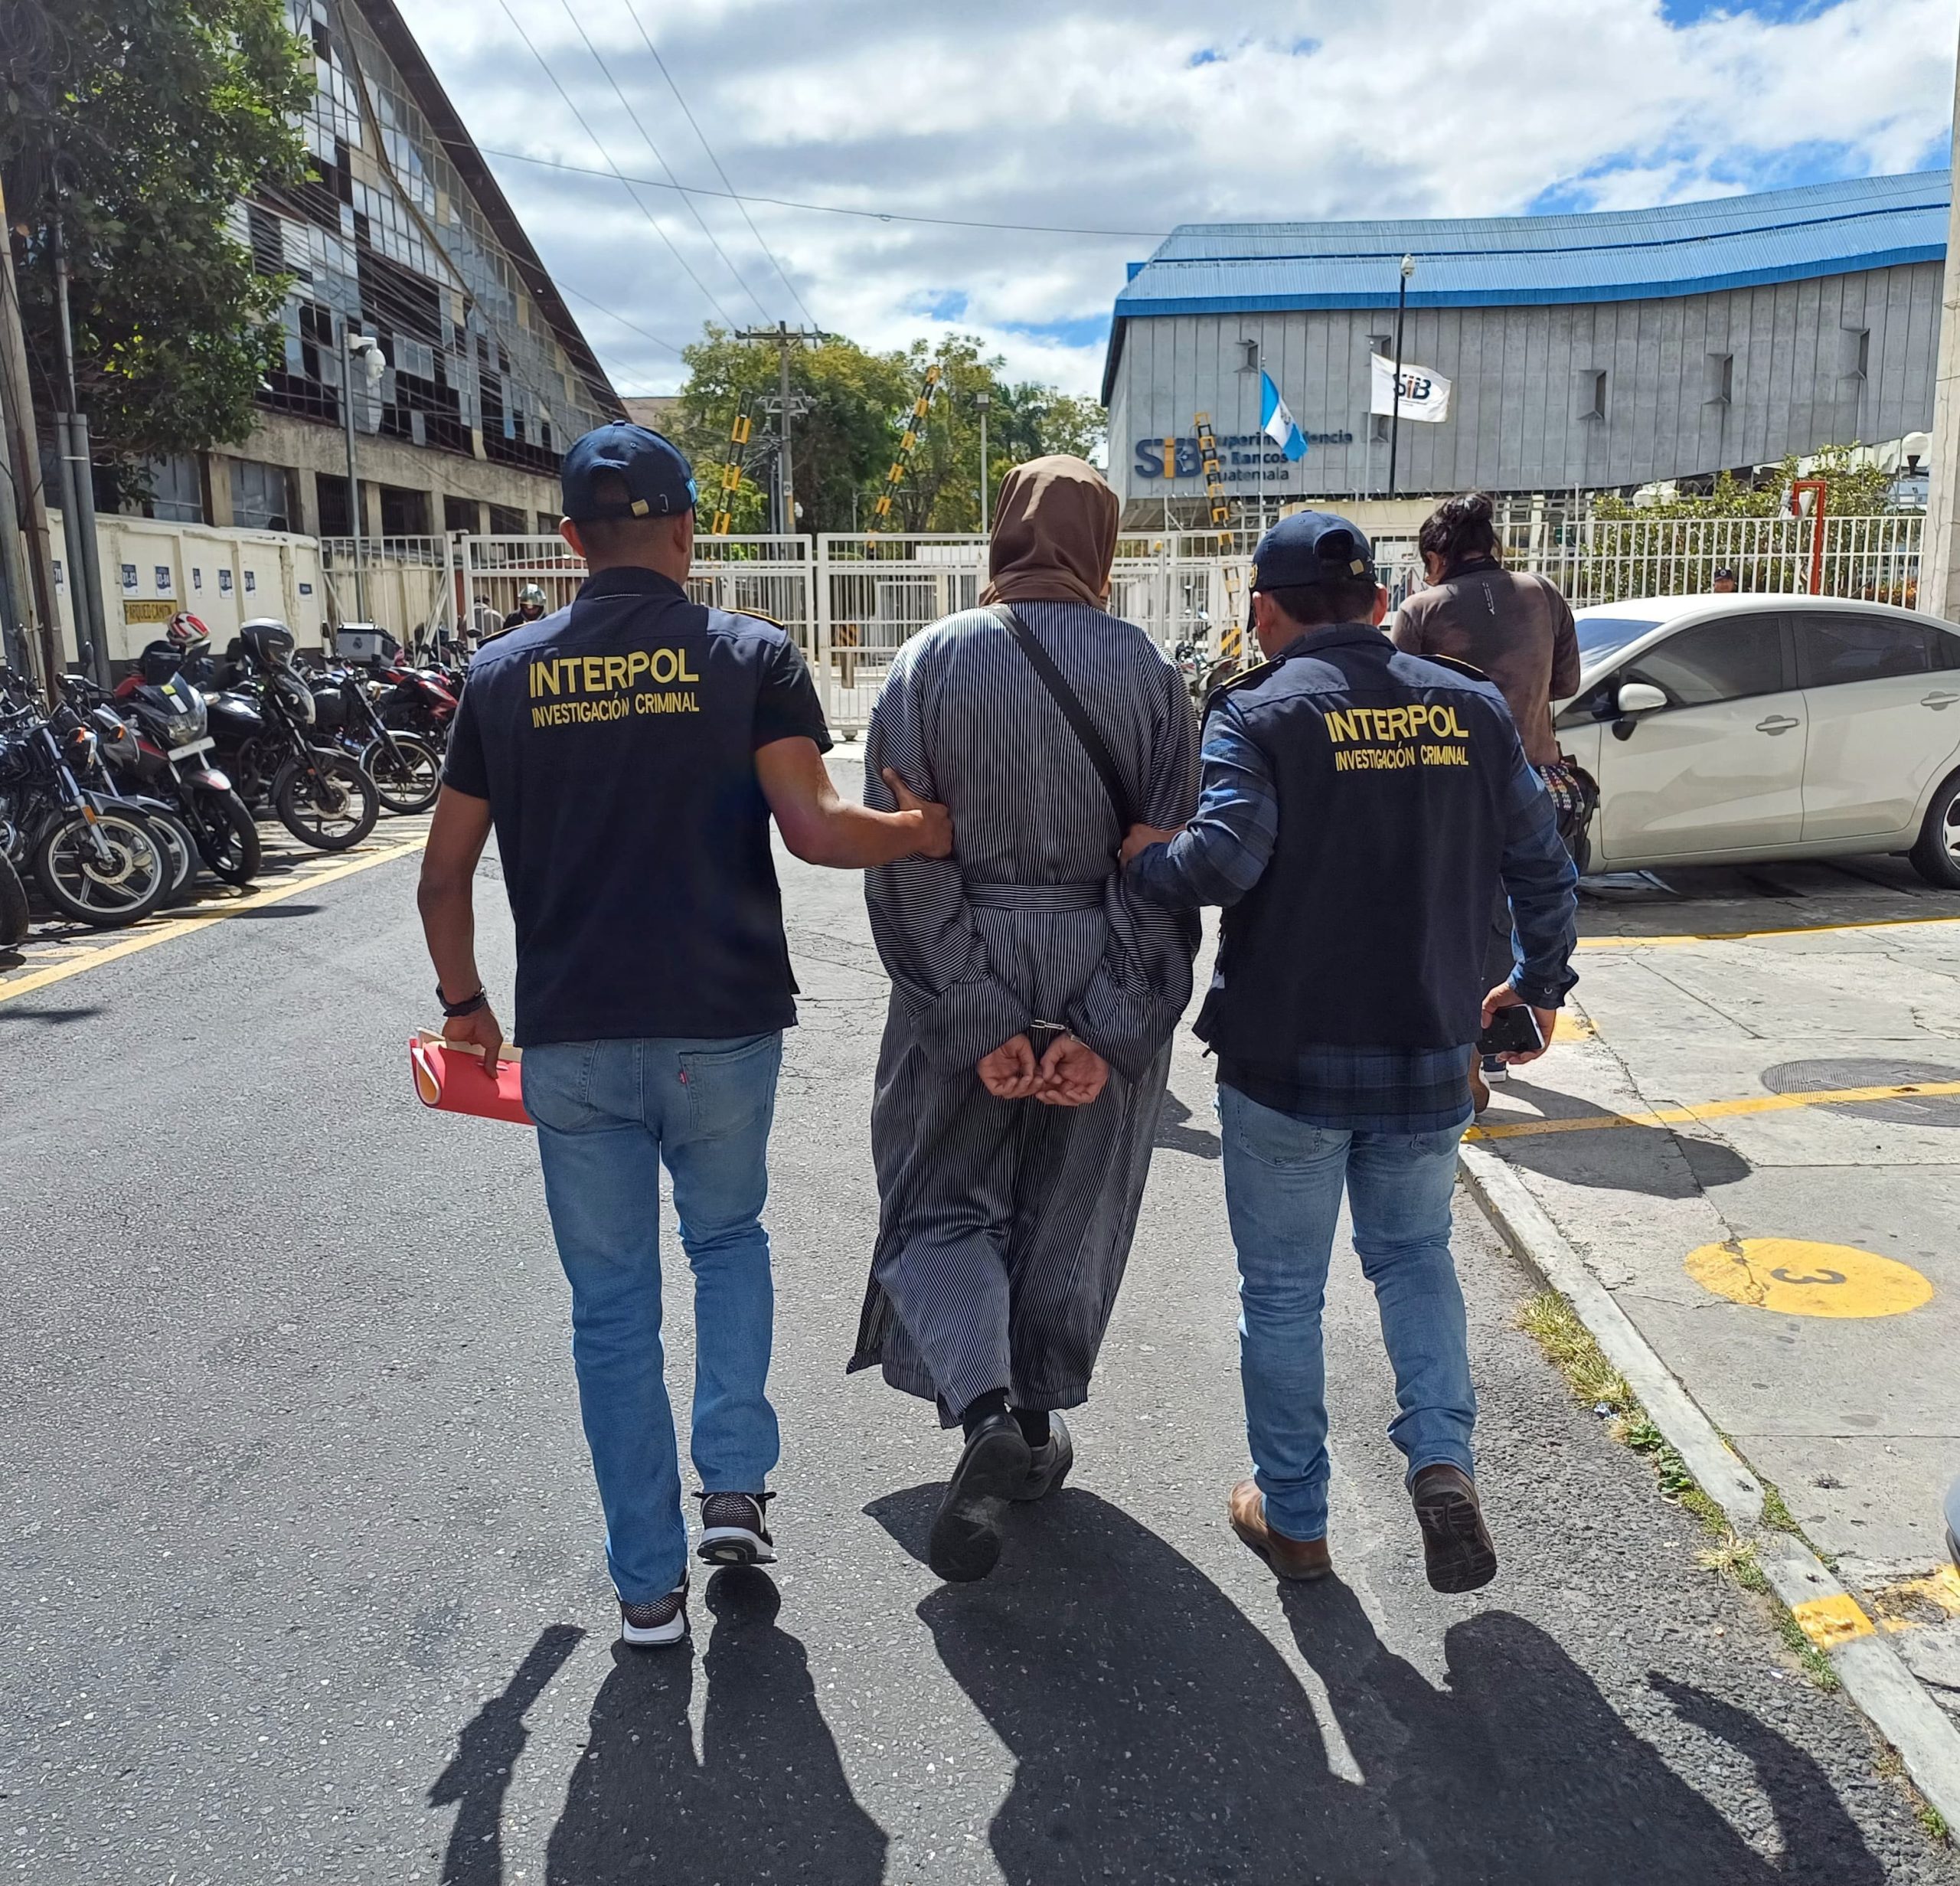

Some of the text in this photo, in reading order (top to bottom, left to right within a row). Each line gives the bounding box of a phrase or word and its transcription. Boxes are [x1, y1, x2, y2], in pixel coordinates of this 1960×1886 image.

[1231, 451, 1289, 464] Bancos
[530, 649, 699, 698] INTERPOL
[532, 691, 700, 728] INVESTIGACIÓN CRIMINAL
[1324, 704, 1468, 743] INTERPOL
[1335, 740, 1468, 772] INVESTIGACIÓN CRIMINAL
